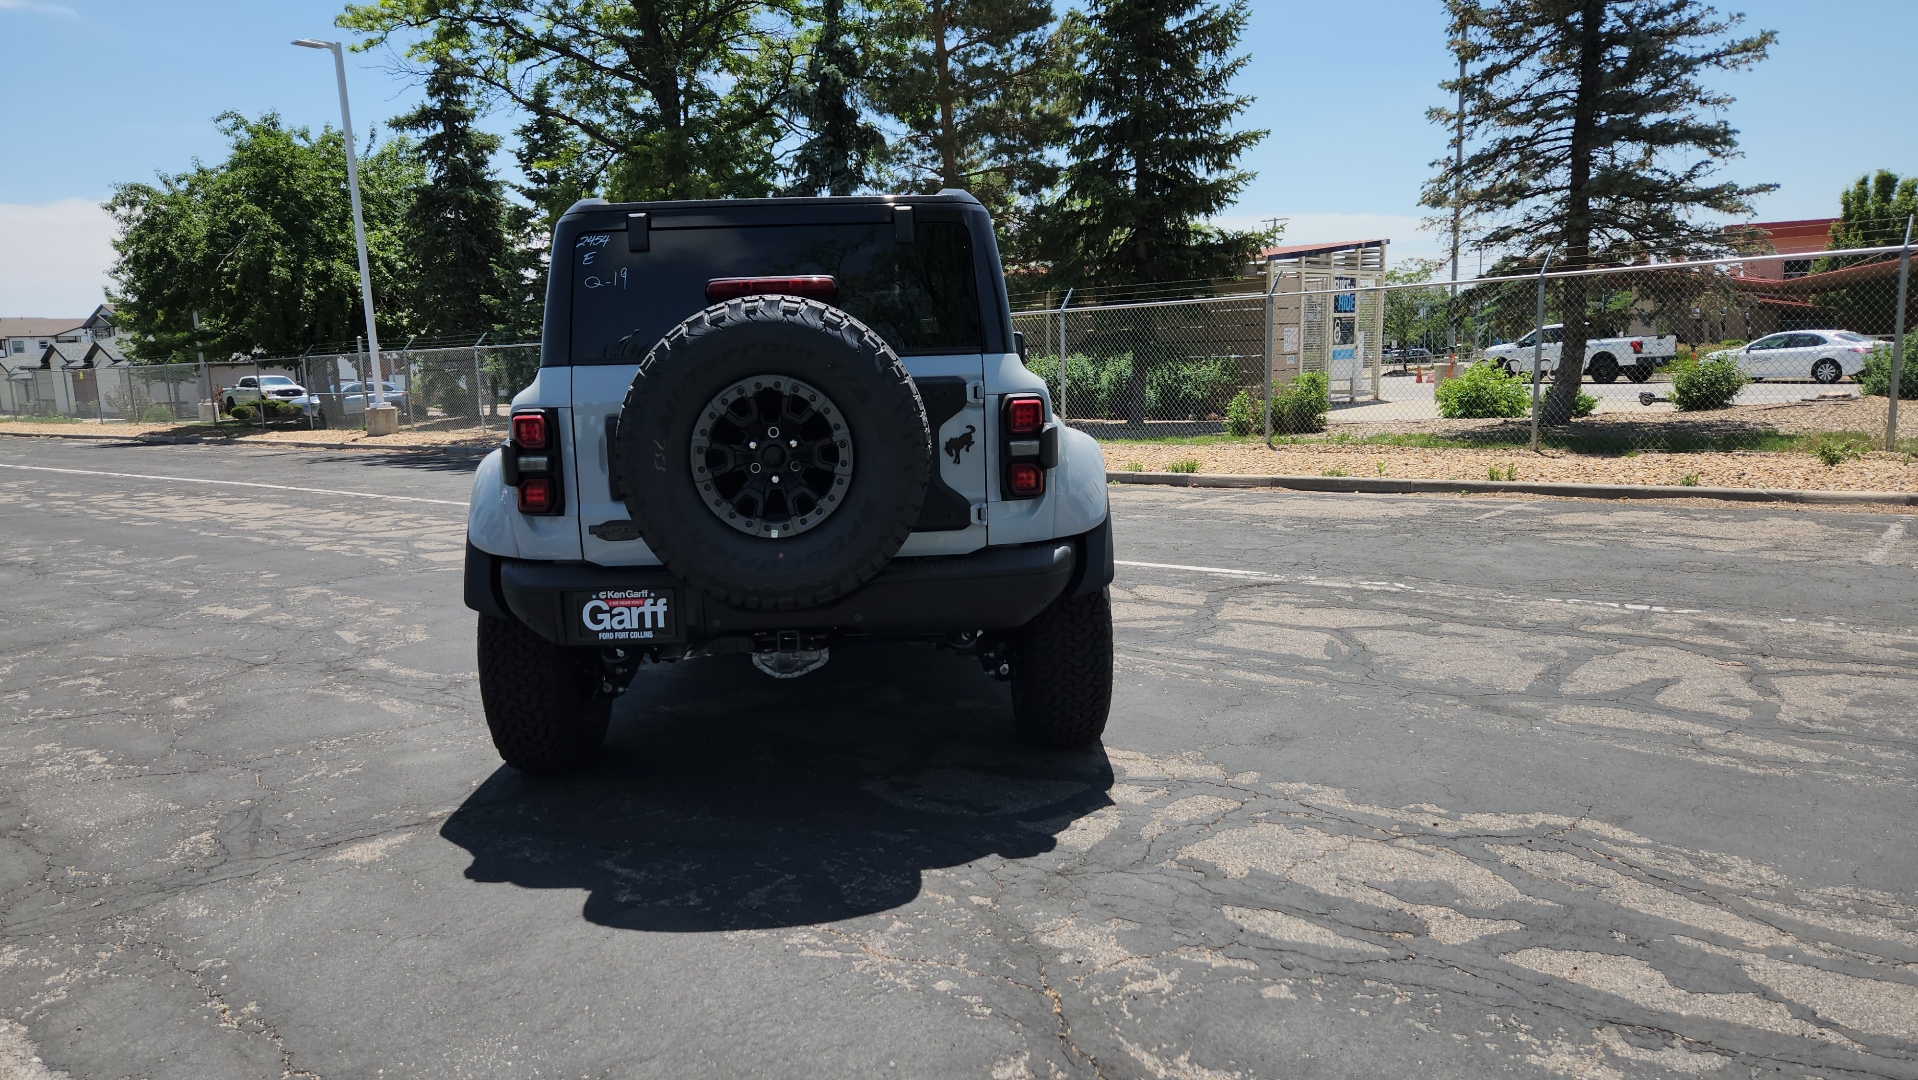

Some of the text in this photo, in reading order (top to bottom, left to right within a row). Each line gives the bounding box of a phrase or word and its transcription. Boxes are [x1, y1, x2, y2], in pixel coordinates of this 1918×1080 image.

[576, 235, 610, 248] 2454
[582, 251, 597, 265] E
[584, 267, 628, 290] Q-19
[582, 598, 667, 631] Garff
[599, 631, 653, 640] FORD FORT COLLINS
